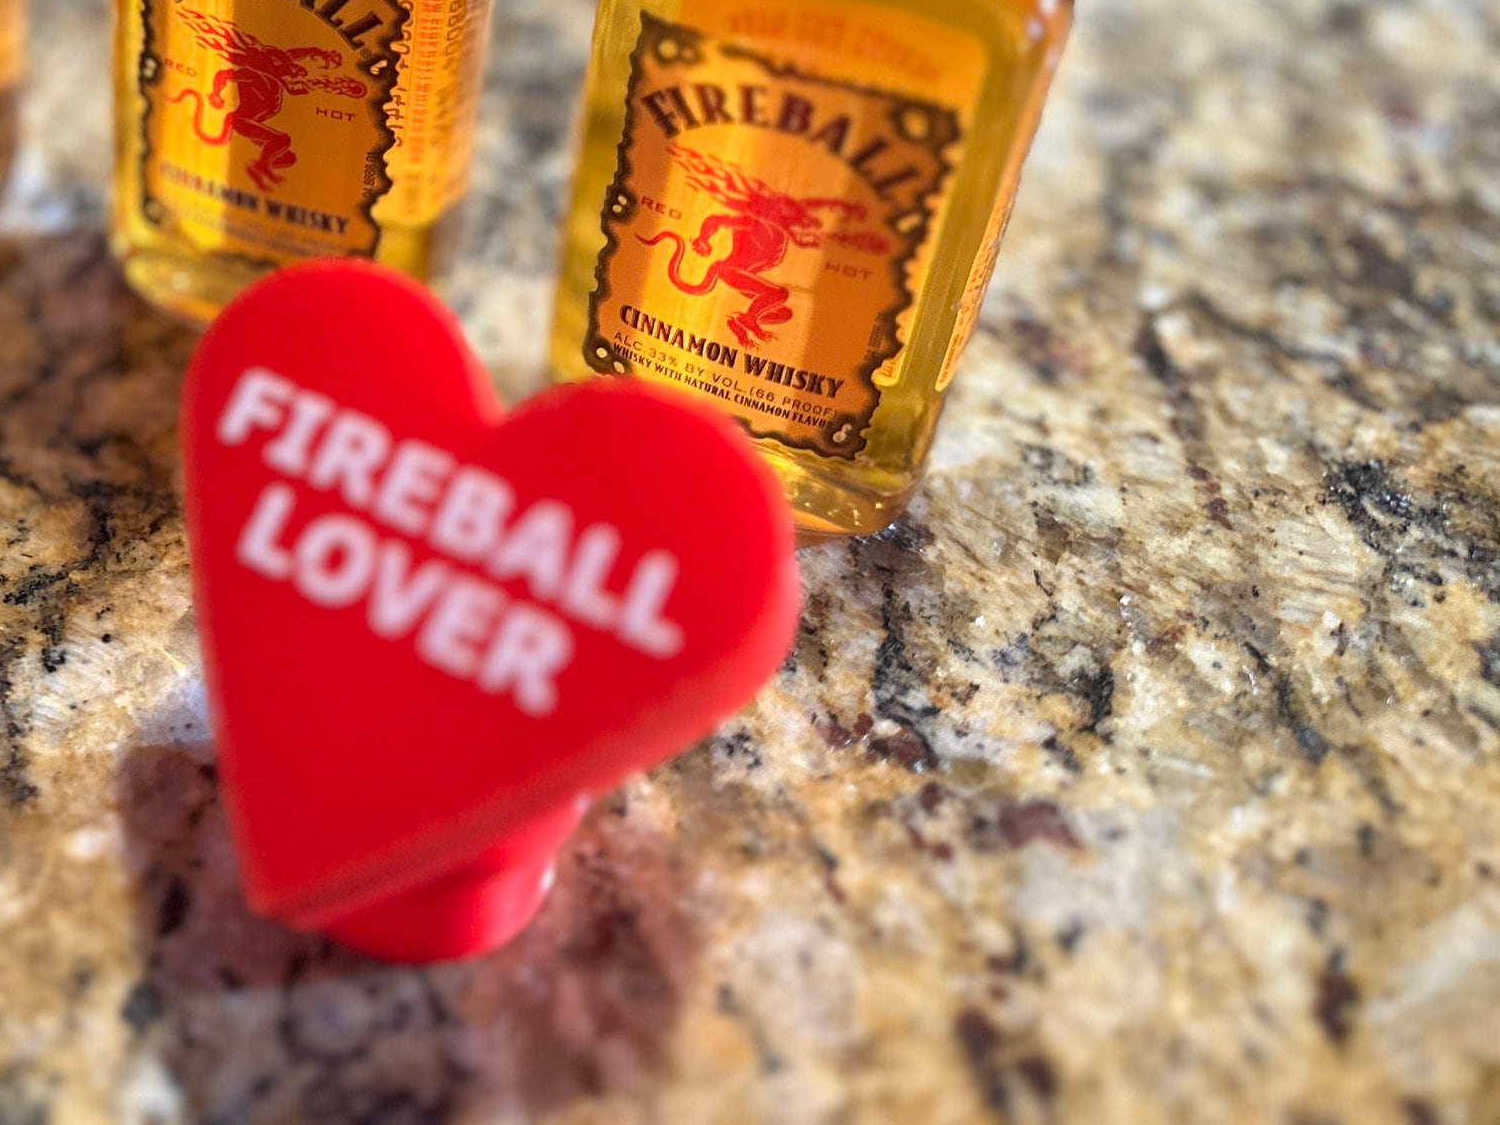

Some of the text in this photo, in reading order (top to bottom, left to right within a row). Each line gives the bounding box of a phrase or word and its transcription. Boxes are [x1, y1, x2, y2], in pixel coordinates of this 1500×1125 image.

[164, 57, 198, 78] RED
[314, 106, 357, 123] HOT
[642, 83, 922, 203] FIREBALL
[265, 198, 349, 235] WHISKY
[640, 195, 682, 221] RED
[824, 260, 873, 281] HOT
[619, 304, 845, 399] CINNAMON WHISKY
[612, 342, 652, 368] WHISKY
[654, 361, 683, 382] WITH
[683, 375, 732, 401] NATURAL
[733, 393, 791, 420] CINNAMON
[684, 361, 705, 377] BY
[781, 395, 837, 419] PROOF)
[215, 367, 687, 660] FIREBALL
[235, 481, 573, 718] LOVER
